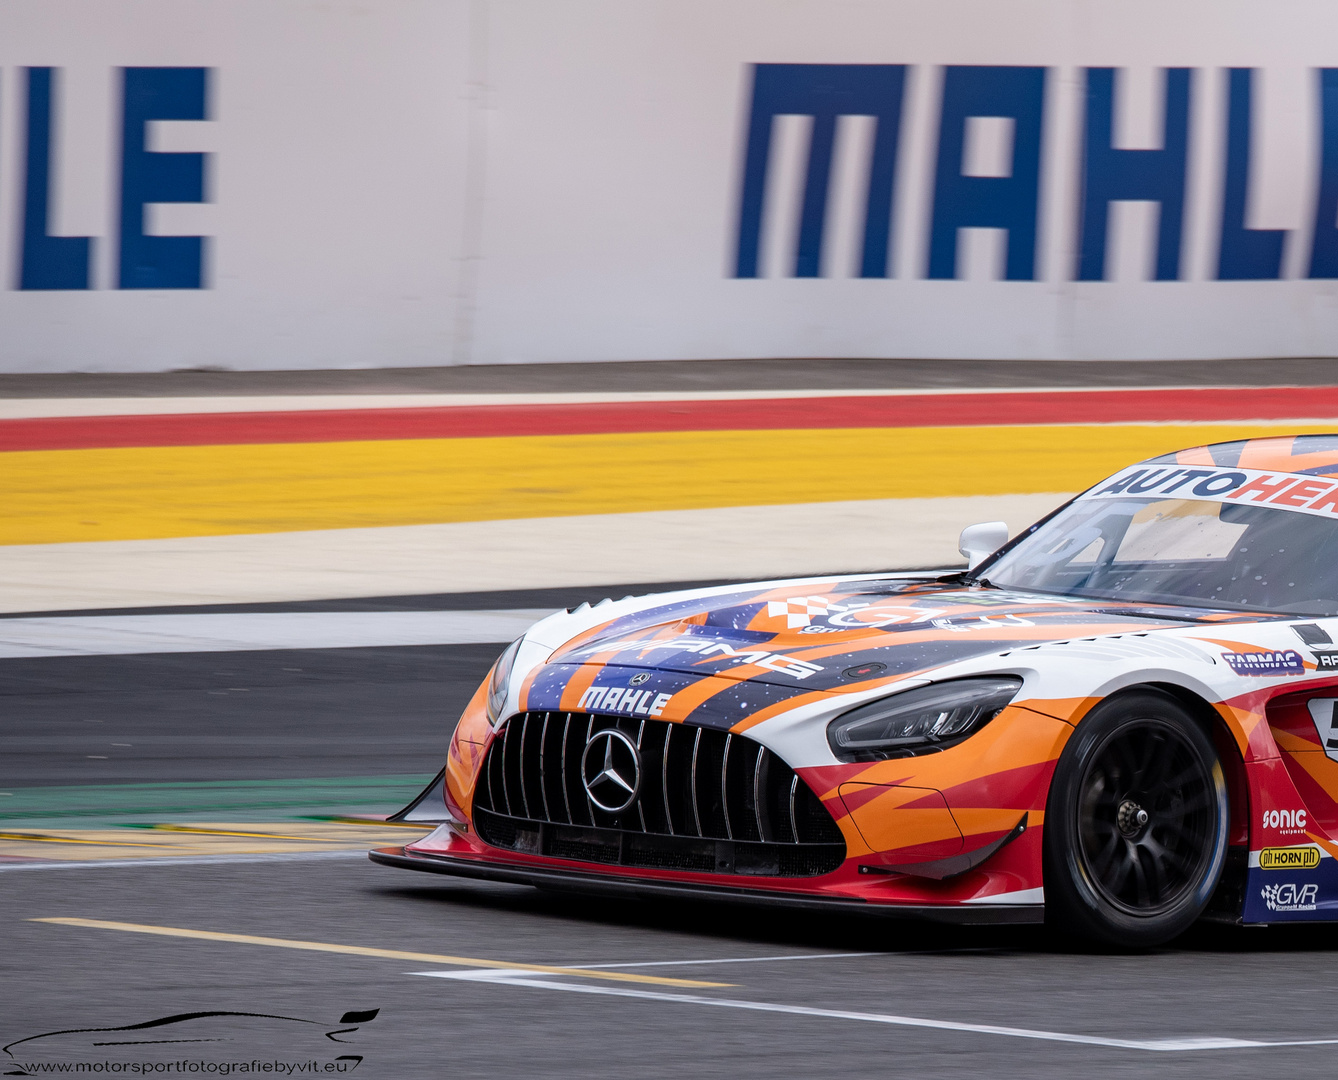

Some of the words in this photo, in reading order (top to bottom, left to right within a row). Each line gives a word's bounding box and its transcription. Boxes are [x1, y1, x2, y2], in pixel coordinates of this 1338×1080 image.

[1224, 653, 1298, 668] TARMAC
[577, 686, 673, 716] MAHLE
[1274, 852, 1301, 863] HORN
[1276, 884, 1318, 904] GVR
